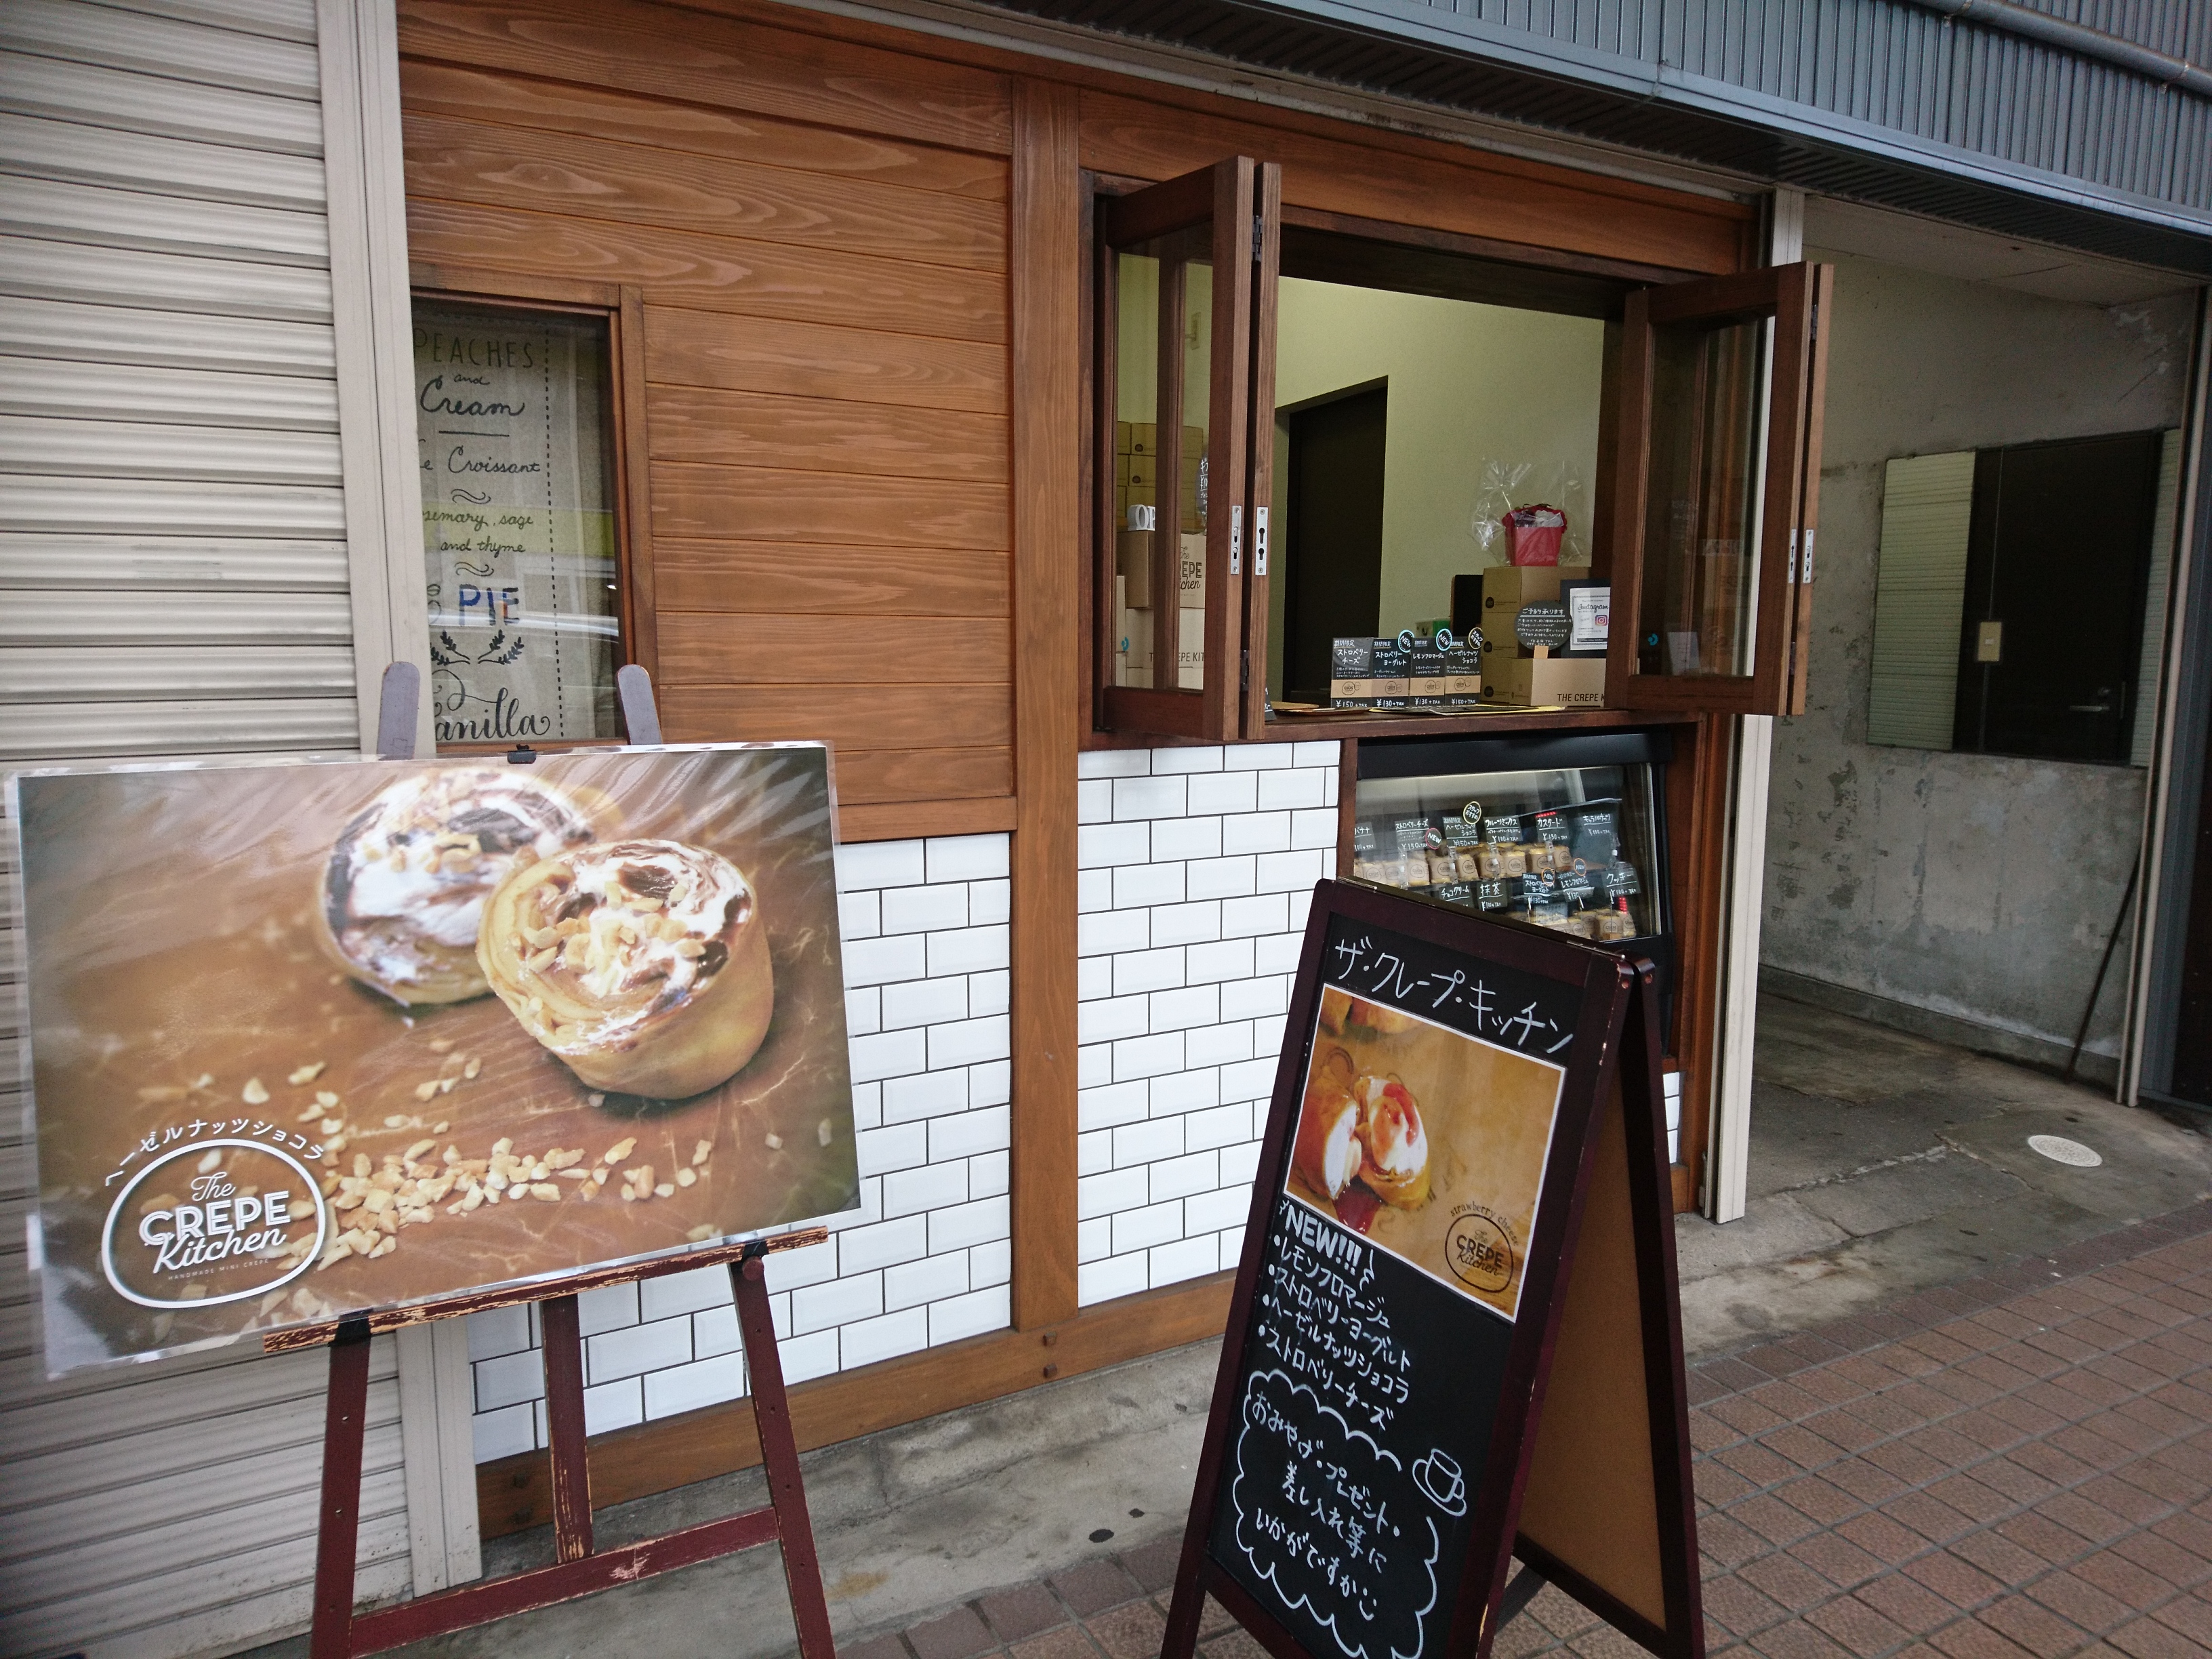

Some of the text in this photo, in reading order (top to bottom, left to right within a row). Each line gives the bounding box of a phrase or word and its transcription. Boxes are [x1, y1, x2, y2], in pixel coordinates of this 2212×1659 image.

[413, 328, 533, 368] PEACHES
[453, 374, 491, 386] and
[419, 375, 525, 416] Cream
[448, 445, 541, 474] Croissant
[422, 510, 534, 531] semary, sage
[441, 535, 526, 558] and thyme
[1181, 561, 1202, 578] EPE
[1180, 576, 1201, 590] chen
[459, 584, 520, 627] PIE
[1578, 604, 1608, 613] Instagram
[1400, 635, 1411, 648] NEW
[1438, 634, 1450, 646] NEW
[1342, 657, 1361, 665] チーズ
[1375, 651, 1403, 659] ストロベリー
[1557, 693, 1572, 701] THE
[1574, 693, 1599, 701] CREPE
[434, 687, 550, 741] anilla
[1395, 818, 1429, 830] ストロベリーチーズ
[1485, 817, 1518, 827] フルーツミックス
[1537, 817, 1563, 827] カスタード
[1427, 832, 1441, 844] NEW
[1606, 873, 1632, 884] クッキー
[1441, 885, 1470, 899] チョコクリーム
[1480, 882, 1502, 897] 抹茶
[1335, 936, 1574, 1054] ザ・クレープ・キッチン
[105, 1119, 325, 1187] ヘーゼルナッツショコラ
[190, 1171, 236, 1202] The
[138, 1190, 291, 1246] CREPE
[1450, 1200, 1519, 1246] strawberry cheese
[1286, 1204, 1361, 1275] NEW!!!
[1474, 1229, 1489, 1244] The
[152, 1227, 287, 1274] Kitchen
[1456, 1234, 1504, 1269] CREPE
[168, 1268, 215, 1280] HANDMADE
[243, 1258, 269, 1267] CREPE
[1456, 1248, 1504, 1276] Kitchen
